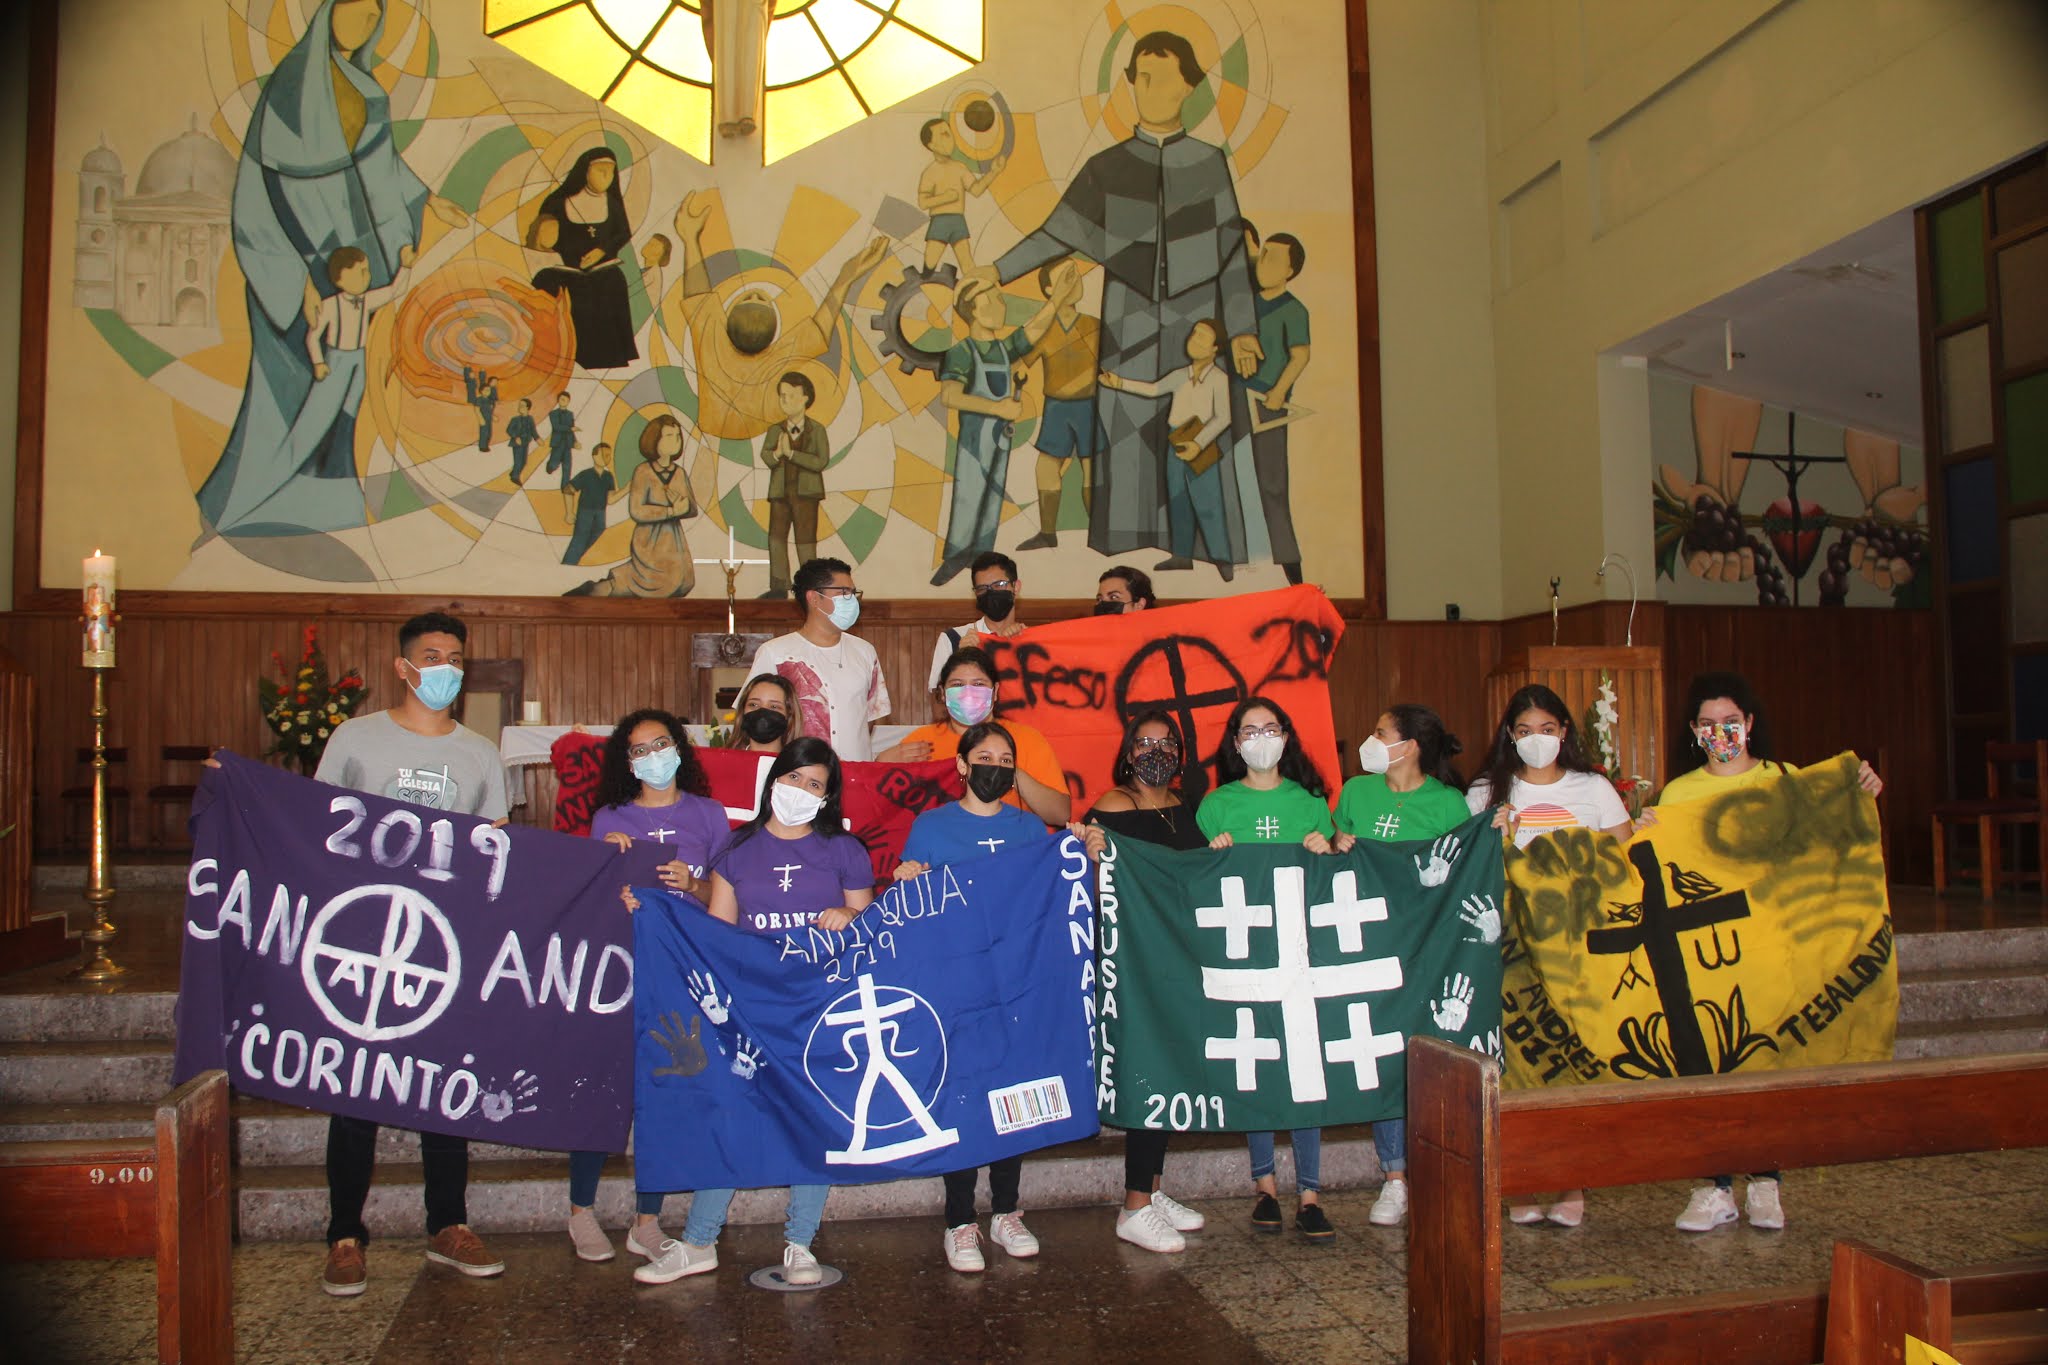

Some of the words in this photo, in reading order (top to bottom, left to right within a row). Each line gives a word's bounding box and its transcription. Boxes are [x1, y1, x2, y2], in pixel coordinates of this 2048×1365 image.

[398, 768, 412, 778] TU
[398, 778, 441, 792] IGLESIA
[325, 795, 512, 901] 2019
[187, 858, 309, 966] SAN
[748, 910, 824, 931] ORINT
[480, 930, 635, 1013] AND
[1098, 836, 1119, 1114] JERUSALEM
[240, 1021, 480, 1121] CORINTO
[1518, 982, 1609, 1081] ANDRES
[1144, 1092, 1225, 1131] 2019
[89, 1166, 154, 1185] 9.00
